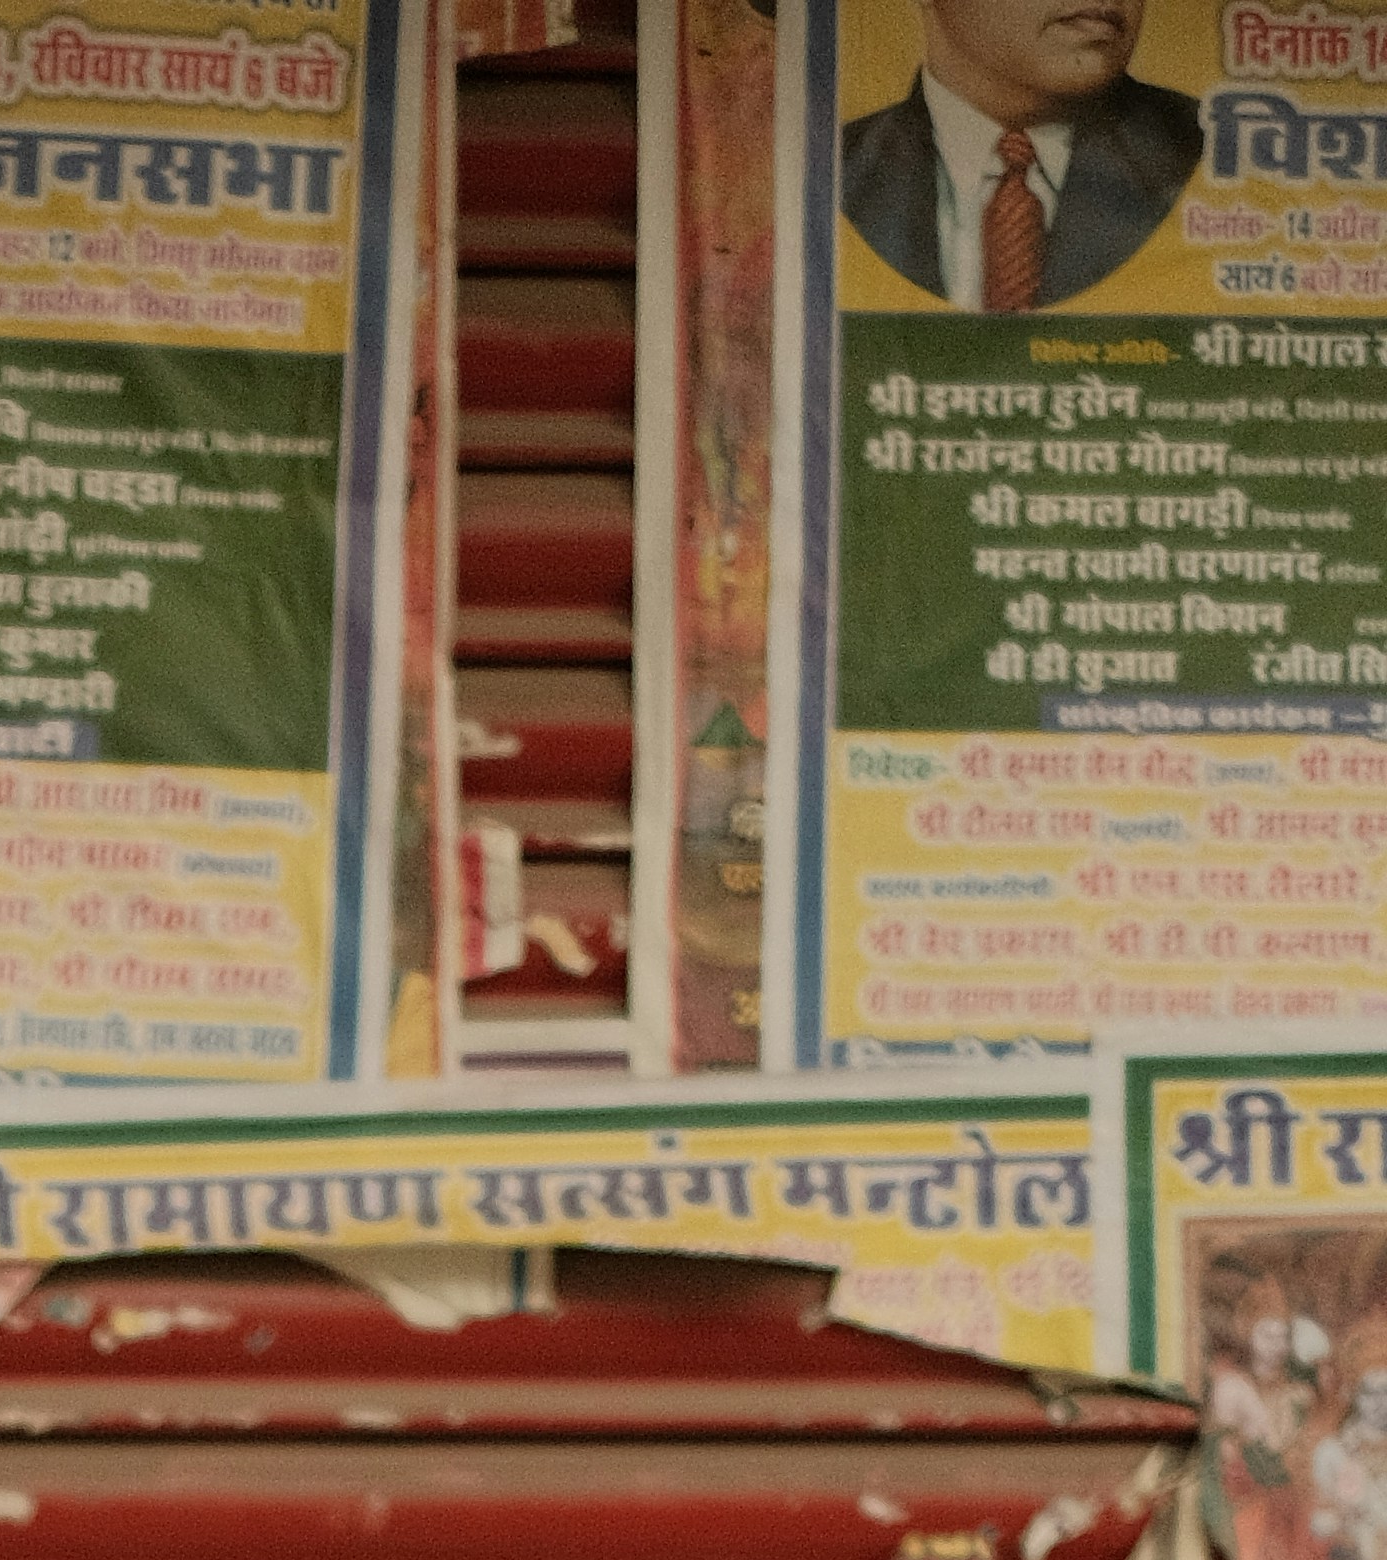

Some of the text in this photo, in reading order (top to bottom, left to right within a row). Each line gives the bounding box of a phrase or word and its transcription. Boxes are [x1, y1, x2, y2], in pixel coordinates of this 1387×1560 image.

[32, 29, 152, 89] रविवार
[161, 37, 239, 92] सायं
[245, 56, 265, 100] 6
[275, 45, 338, 103] बजे
[1190, 323, 1365, 367] श्री गोपाल
[867, 373, 1140, 430] श्री इमरान हुसैन
[863, 432, 914, 473] श्री
[1042, 441, 1118, 474] पाल
[1126, 437, 1232, 475] गौतम
[972, 485, 1126, 529] श्री कमल
[1172, 1089, 1303, 1189] श्री
[42, 1169, 447, 1250] रामायण
[464, 1129, 756, 1229] सत्संग
